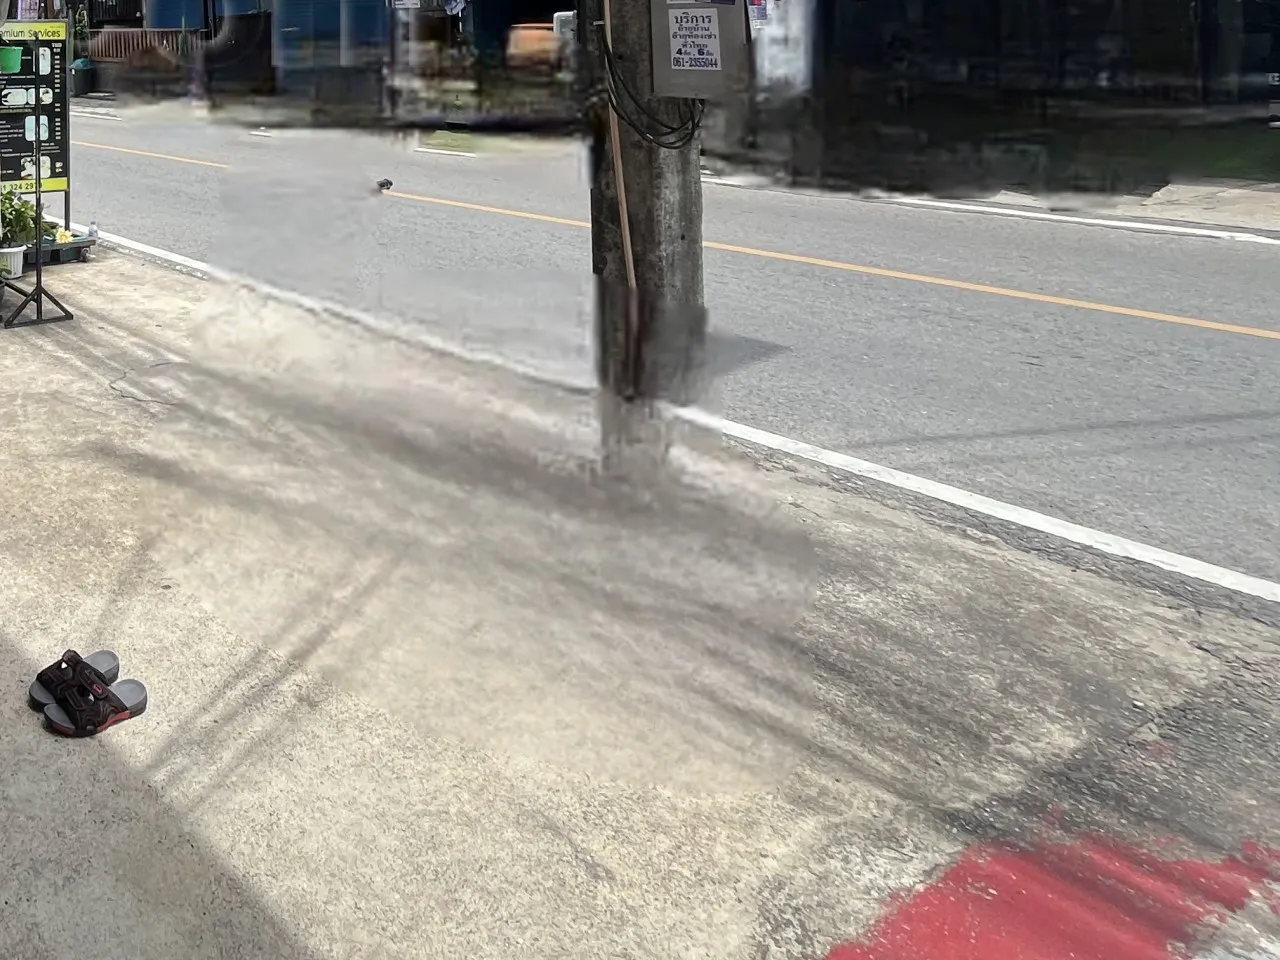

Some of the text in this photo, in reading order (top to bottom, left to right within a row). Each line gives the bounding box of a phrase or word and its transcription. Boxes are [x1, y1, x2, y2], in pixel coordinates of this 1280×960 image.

[674, 11, 712, 24] บริการ
[28, 28, 61, 38] Services
[9, 183, 23, 191] 324
